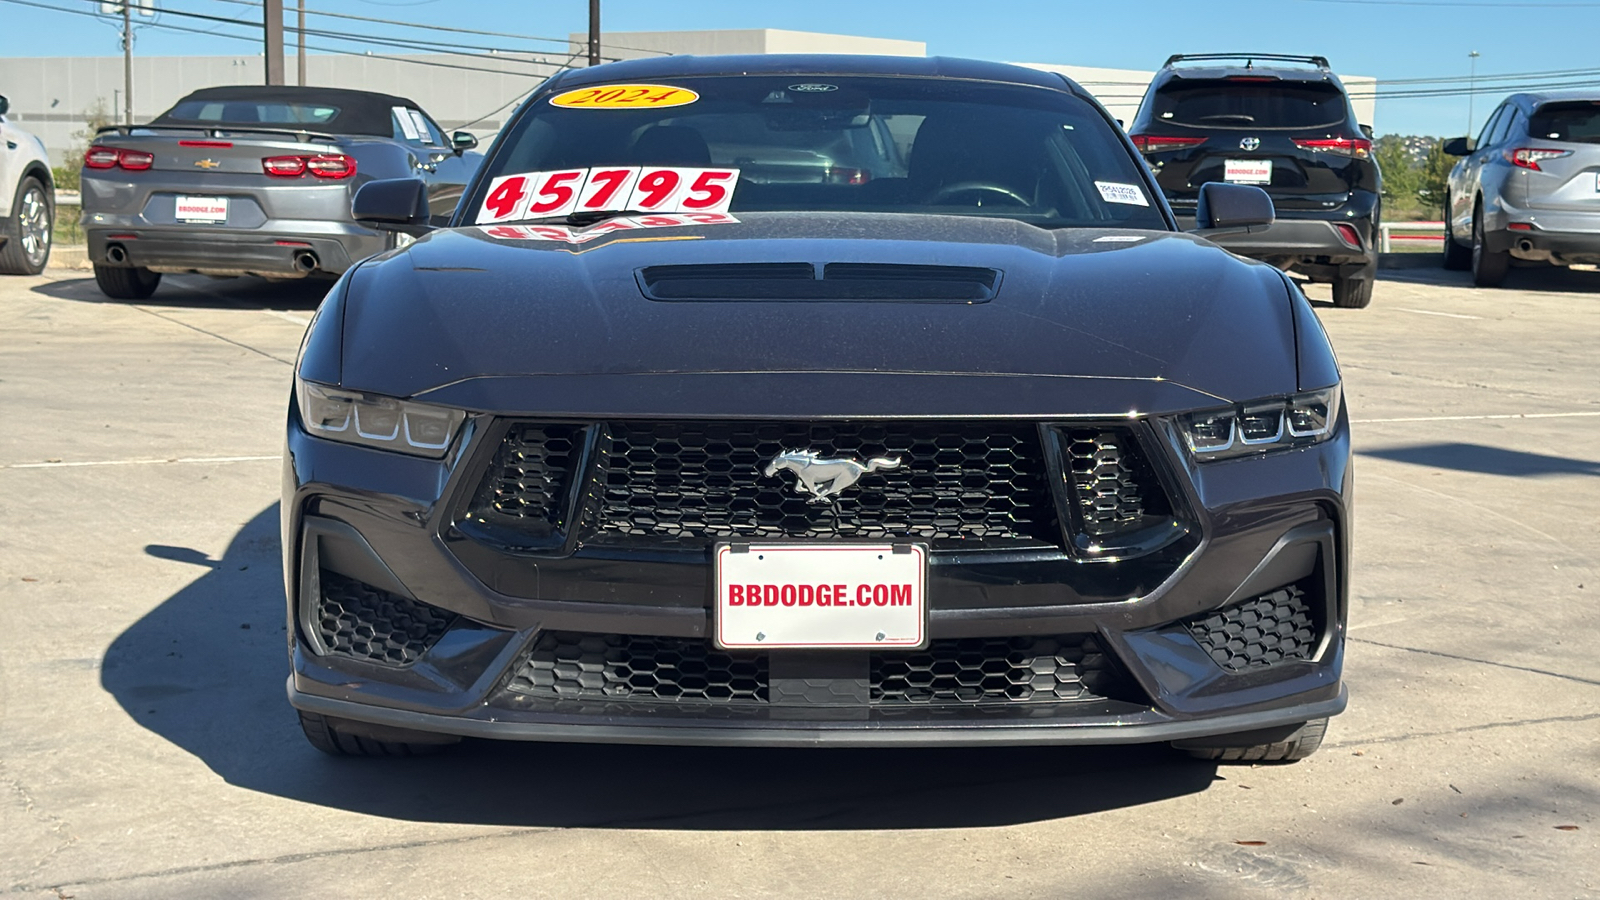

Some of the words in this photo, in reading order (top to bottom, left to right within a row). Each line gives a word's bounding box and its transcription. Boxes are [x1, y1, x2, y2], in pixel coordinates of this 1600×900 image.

[568, 89, 680, 104] 2024
[486, 169, 735, 219] 45795
[178, 205, 226, 213] BBDODGE.COM
[728, 583, 912, 607] BBDODGE.COM
